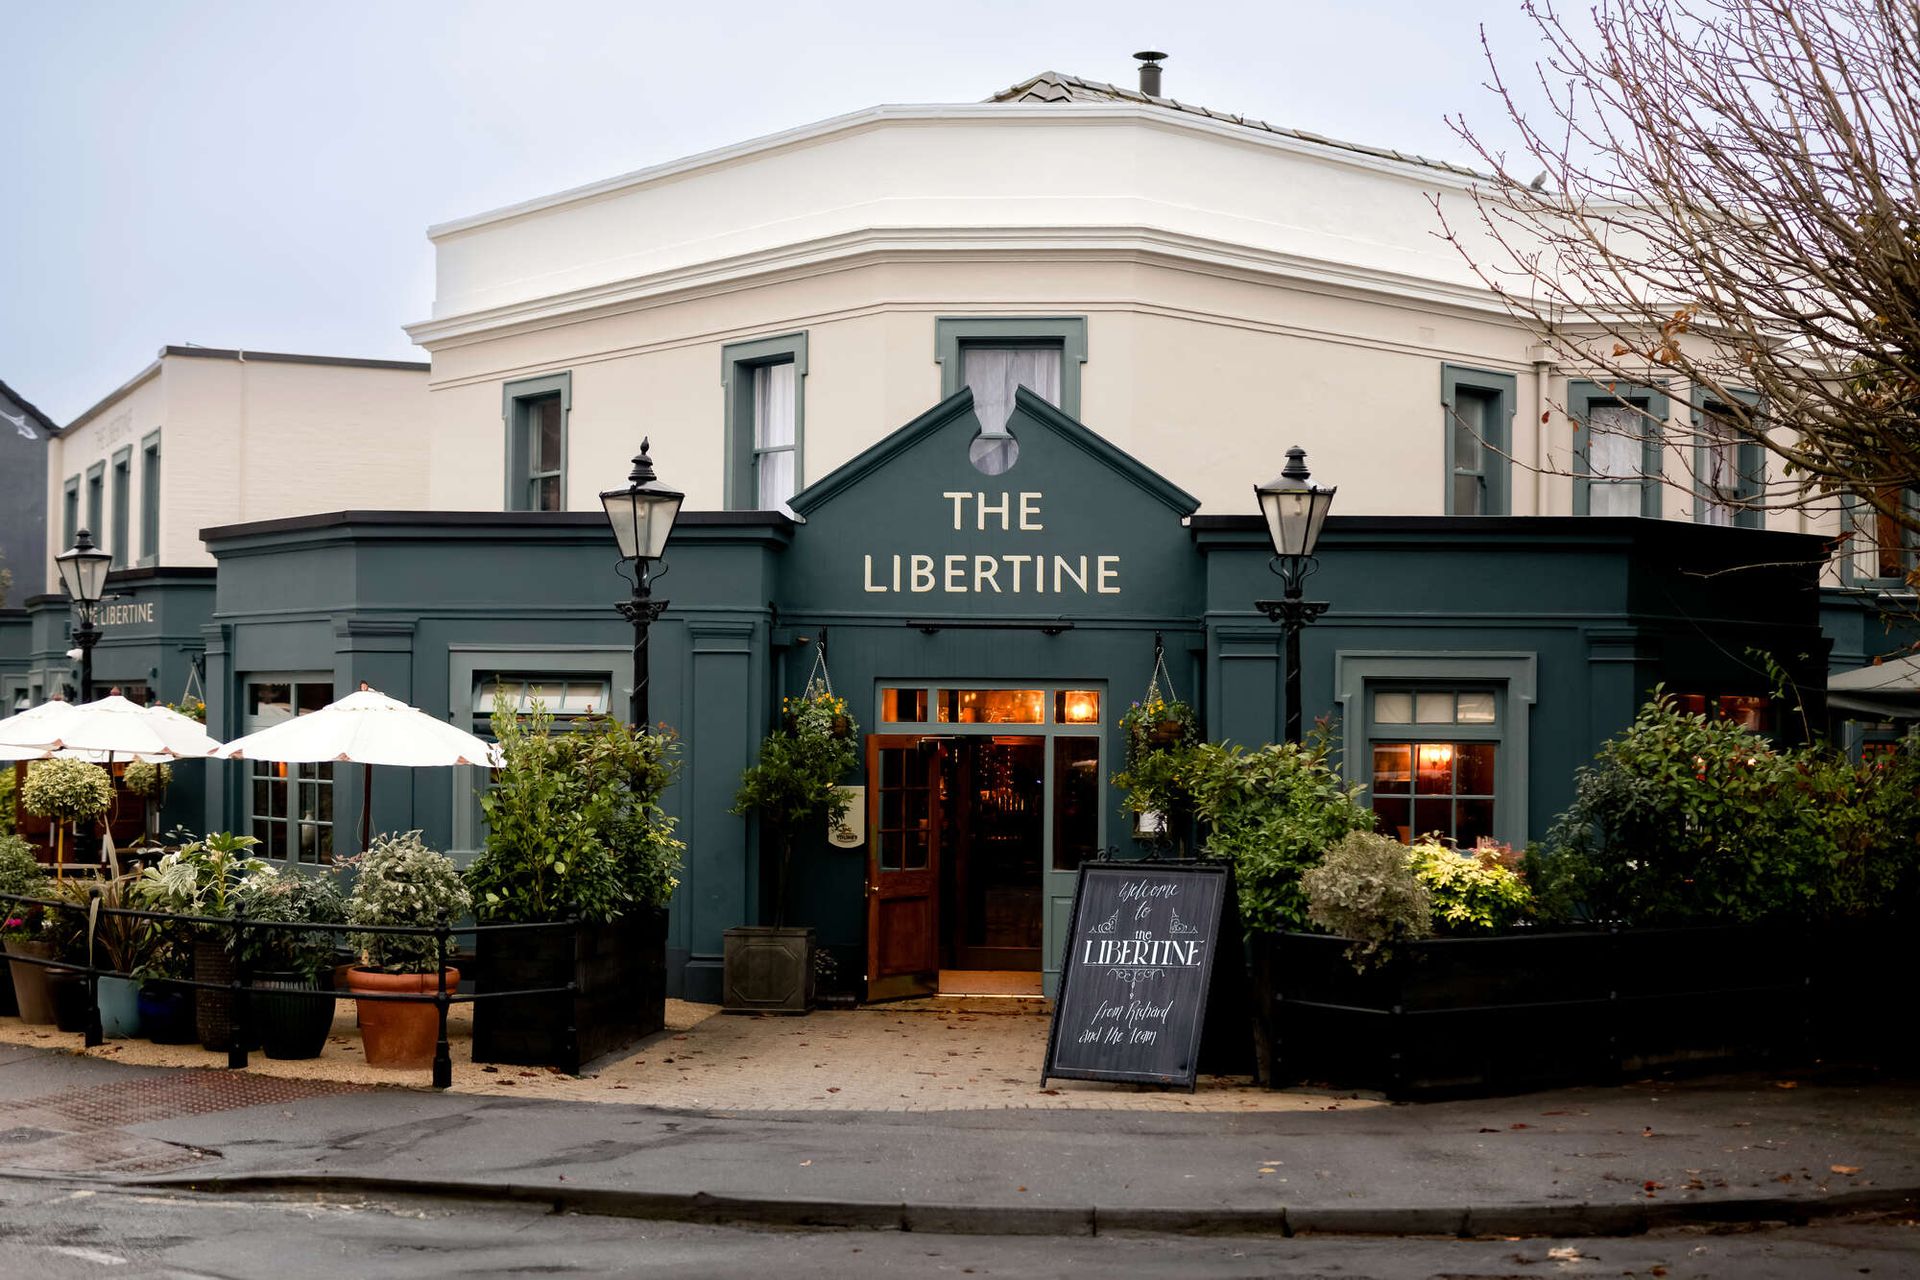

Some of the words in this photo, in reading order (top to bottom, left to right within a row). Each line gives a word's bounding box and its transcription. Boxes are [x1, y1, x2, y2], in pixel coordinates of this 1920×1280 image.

[943, 491, 1044, 531] THE
[863, 554, 1121, 594] LIBERTINE
[101, 602, 154, 626] LIBERTINE
[1118, 879, 1179, 902] Welcome
[1134, 900, 1152, 921] to
[1083, 939, 1205, 966] LIBERTINE
[1090, 999, 1124, 1026] from
[1125, 999, 1174, 1029] Richard
[1078, 1026, 1103, 1044] and
[1103, 1026, 1124, 1045] the
